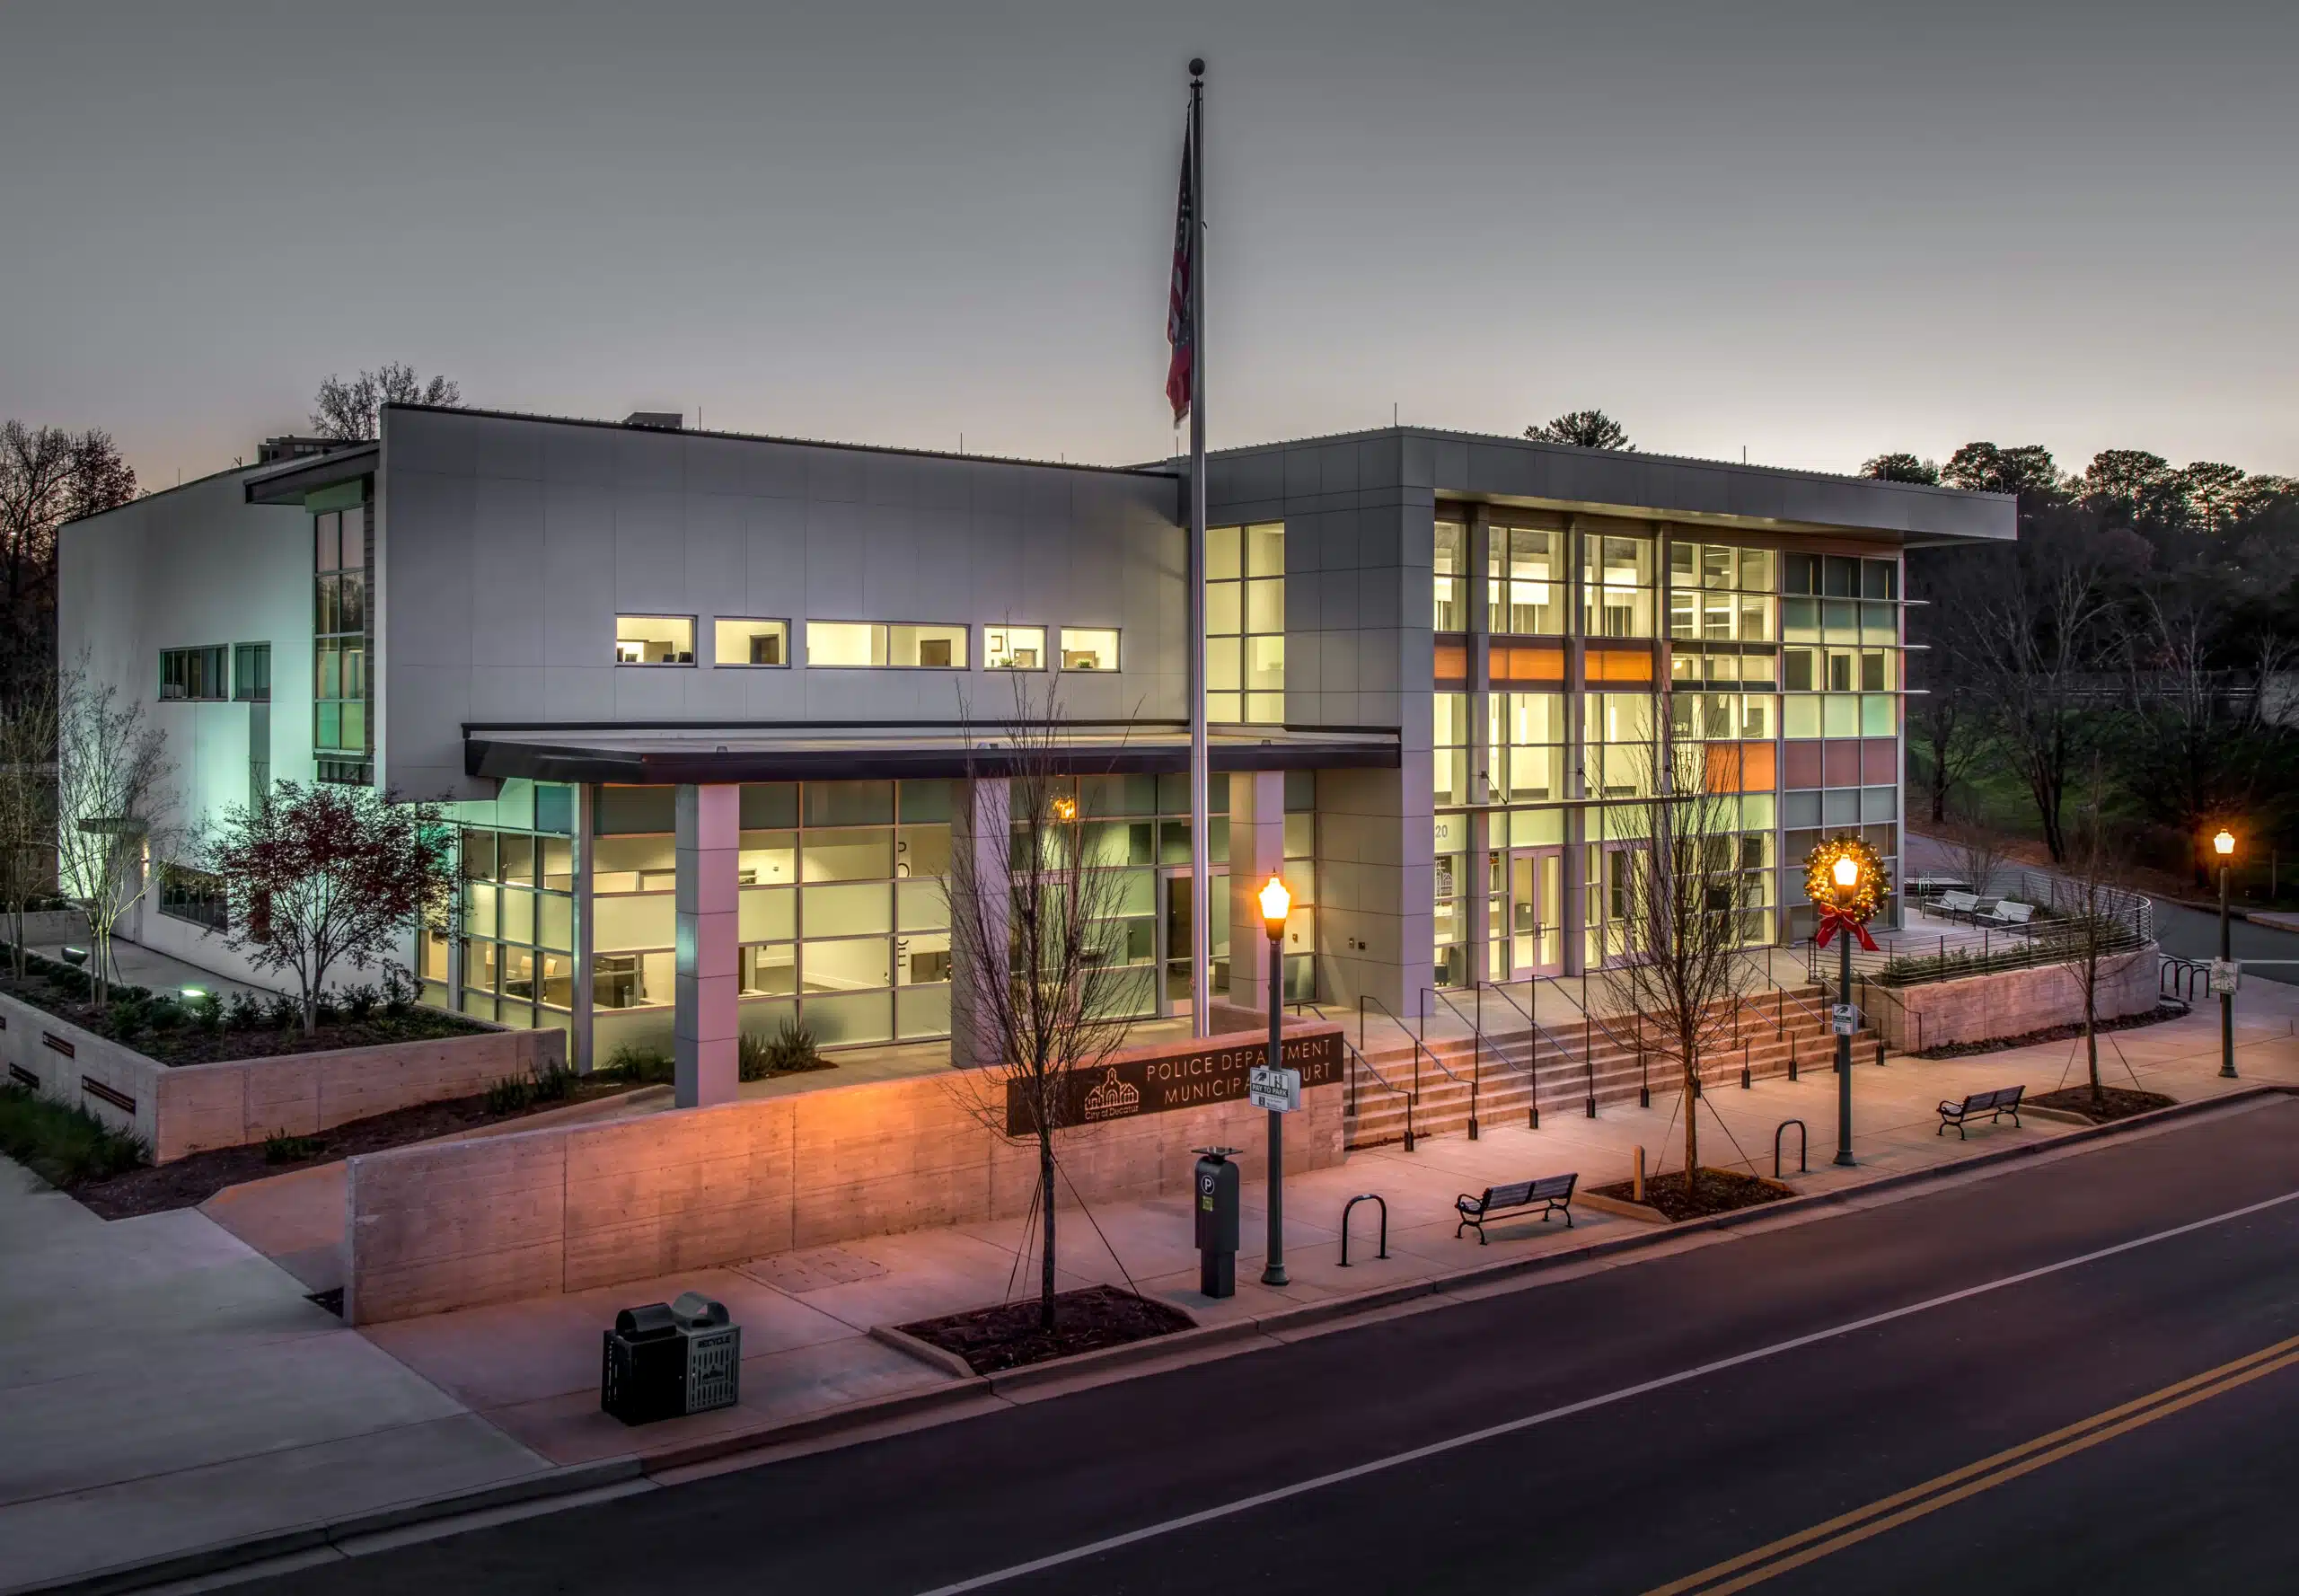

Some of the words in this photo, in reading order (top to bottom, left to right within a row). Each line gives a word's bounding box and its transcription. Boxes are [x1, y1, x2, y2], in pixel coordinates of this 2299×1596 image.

[1147, 1056, 1212, 1082] POLICE
[1222, 1040, 1329, 1071] DEPATMENT
[1165, 1074, 1250, 1105] MUNICIPA
[1253, 1084, 1262, 1092] PAY
[1264, 1086, 1271, 1094] TO
[1273, 1089, 1287, 1097] PARK
[1085, 1111, 1100, 1120] City
[698, 1335, 730, 1348] RECYCLE
